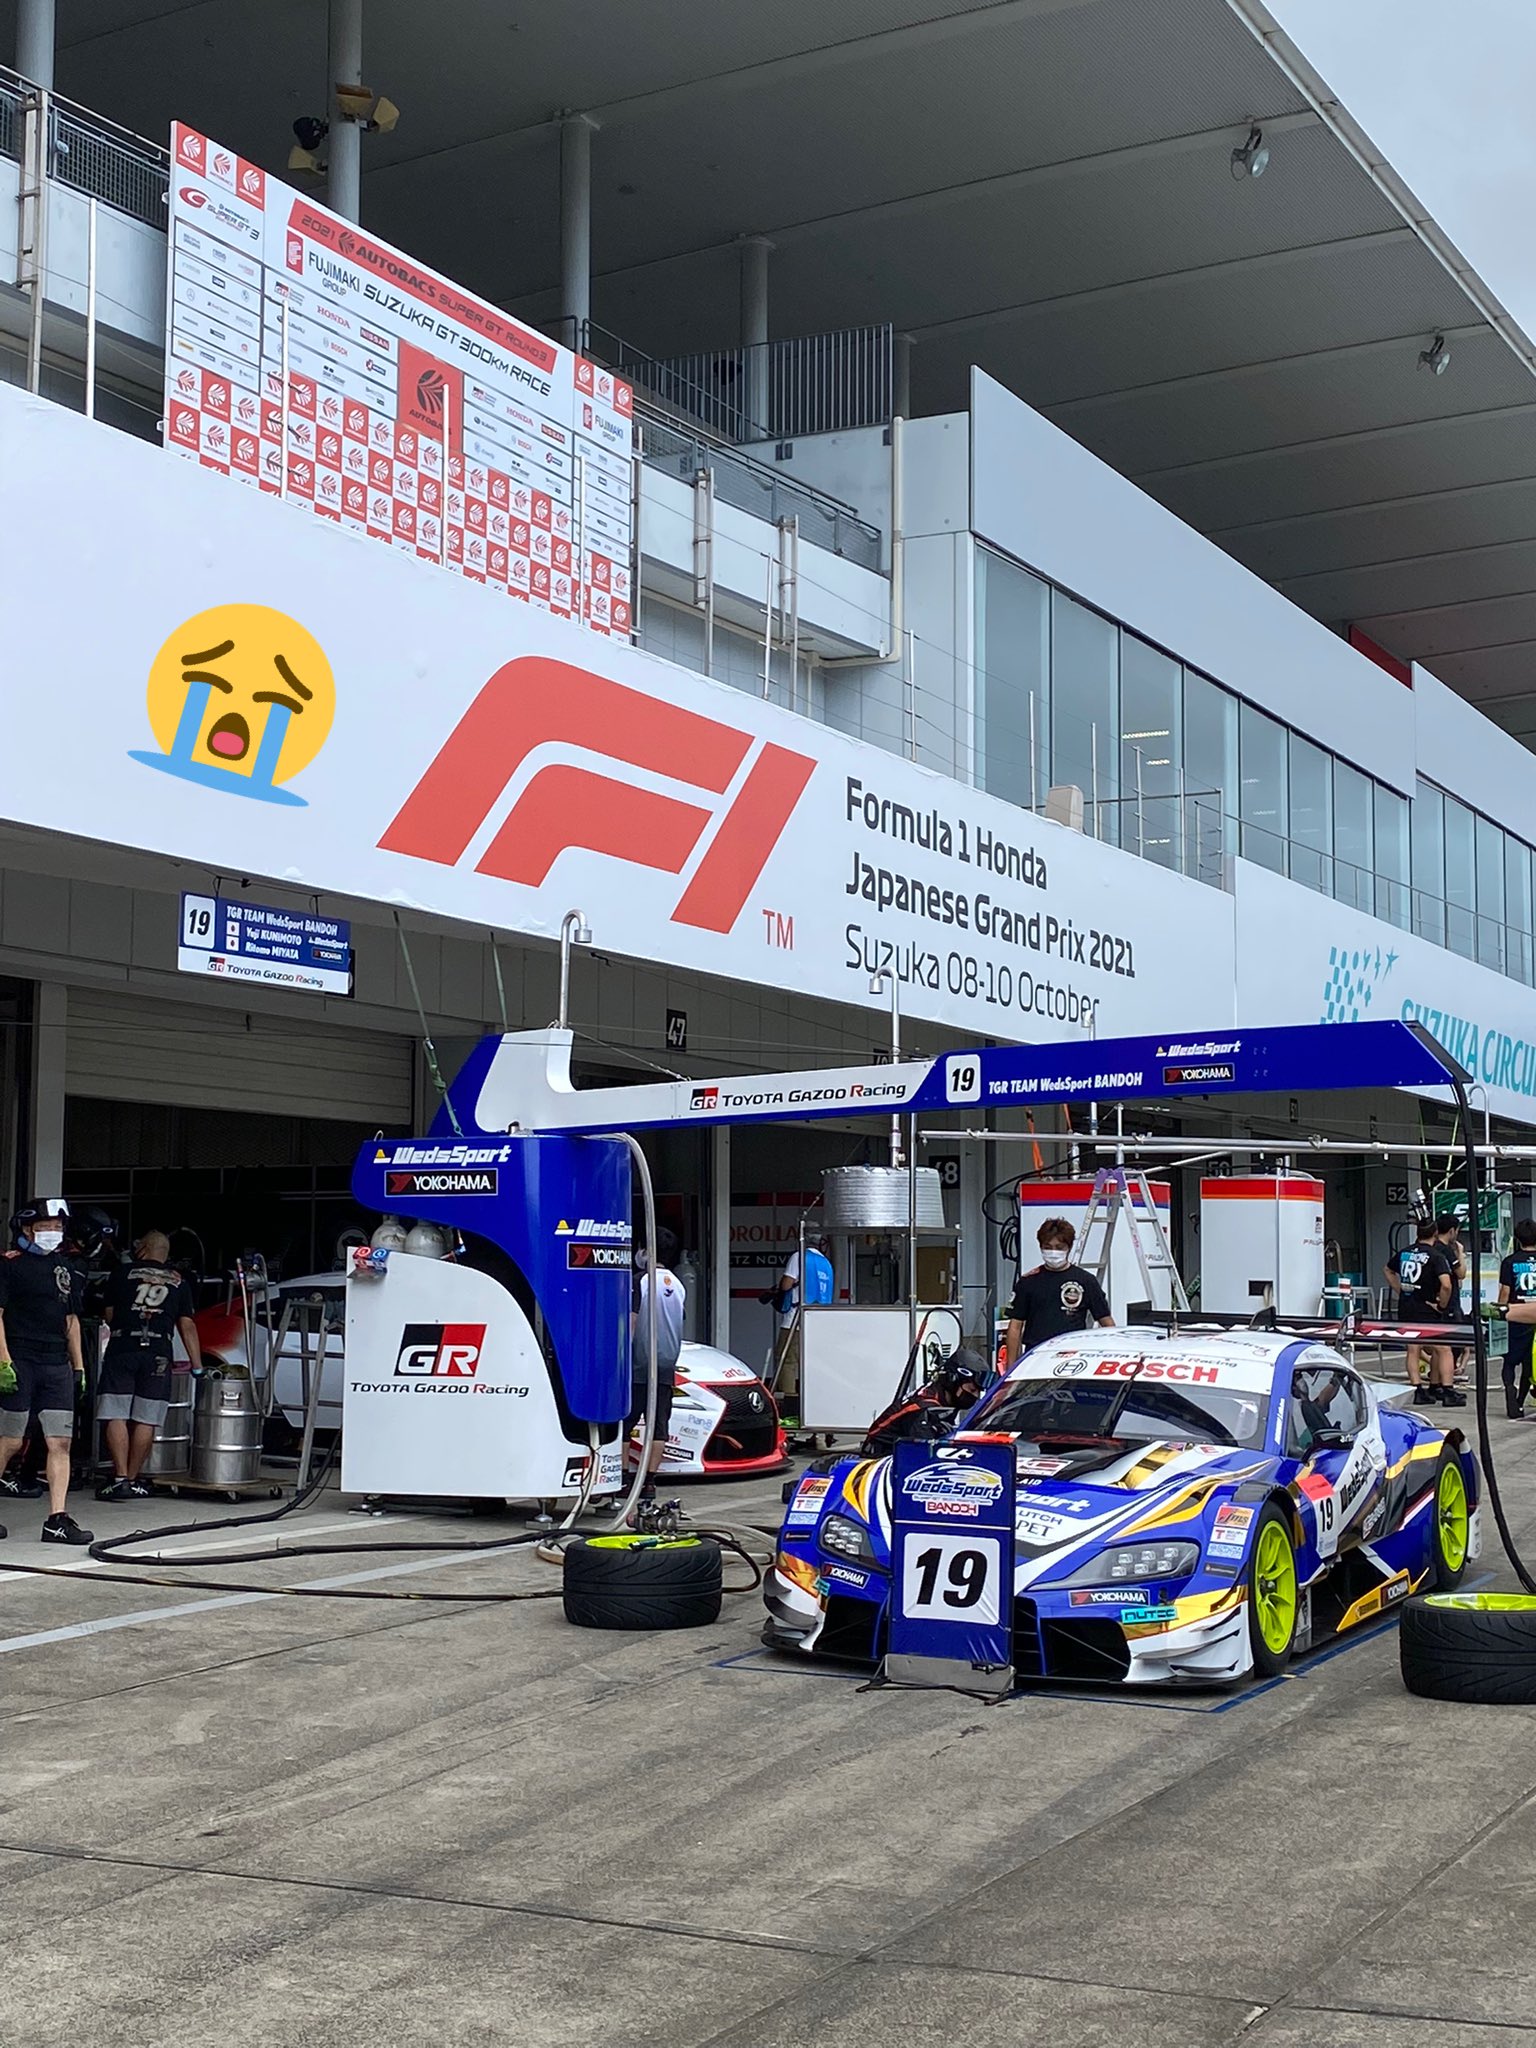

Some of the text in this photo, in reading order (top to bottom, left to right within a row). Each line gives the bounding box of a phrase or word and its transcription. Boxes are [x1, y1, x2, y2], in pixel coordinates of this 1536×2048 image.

[249, 228, 260, 241] 3
[301, 214, 336, 240] 2021
[356, 246, 437, 298] AUTOBACS
[438, 293, 484, 323] SUPER
[485, 321, 505, 336] GT
[322, 277, 347, 296] GROUP
[308, 251, 360, 293] FUJIMAKI
[363, 283, 436, 332] SUZUKA
[435, 324, 460, 344] GT
[509, 365, 552, 397] RACE
[317, 305, 351, 329] HONDA
[361, 328, 389, 350] NISSAN
[408, 408, 451, 434] AUTOBA
[506, 406, 534, 427] HONDA
[847, 775, 1047, 890] Formula 1 Honda
[188, 908, 211, 936] 19
[226, 905, 338, 936] TGR TEAM WedsSport BANDOH
[846, 851, 1136, 979] Japanese Grand Prix 2021
[246, 926, 302, 946] Yuji KUNIMOTO
[762, 908, 794, 951] TM
[271, 945, 300, 960] MIYATA
[226, 963, 262, 977] TOYOTA
[263, 969, 295, 982] GAZOO
[295, 975, 324, 988] Racing
[845, 923, 1100, 1024] Suzuka 08-10 October
[667, 1017, 686, 1046] 47
[1167, 1040, 1242, 1057] WedsSport
[951, 1066, 975, 1093] 19
[988, 1071, 1143, 1095] TGR TEAM WedsSport BANDOH
[1181, 1067, 1231, 1080] YOKOHAMA
[690, 1083, 907, 1110] GR TOYOTA GAZOO Racing
[391, 1145, 512, 1167] WedsSport
[413, 1175, 492, 1191] YOKOHAMA
[1387, 1186, 1408, 1202] 52
[134, 1283, 169, 1307] 19
[397, 1344, 480, 1376] GR
[1078, 1351, 1130, 1360] TOYOTA
[1132, 1354, 1185, 1362] GAZOO
[1188, 1358, 1238, 1368] Racing
[1093, 1360, 1219, 1383] BOSCH
[351, 1382, 530, 1398] TOYOTA GAZOO Racing
[904, 1479, 1002, 1499] WedsSport
[927, 1502, 977, 1514] BANDOH
[1319, 1497, 1334, 1532] 19
[915, 1547, 988, 1608] 19
[1090, 1592, 1147, 1604] YOKOHAMA
